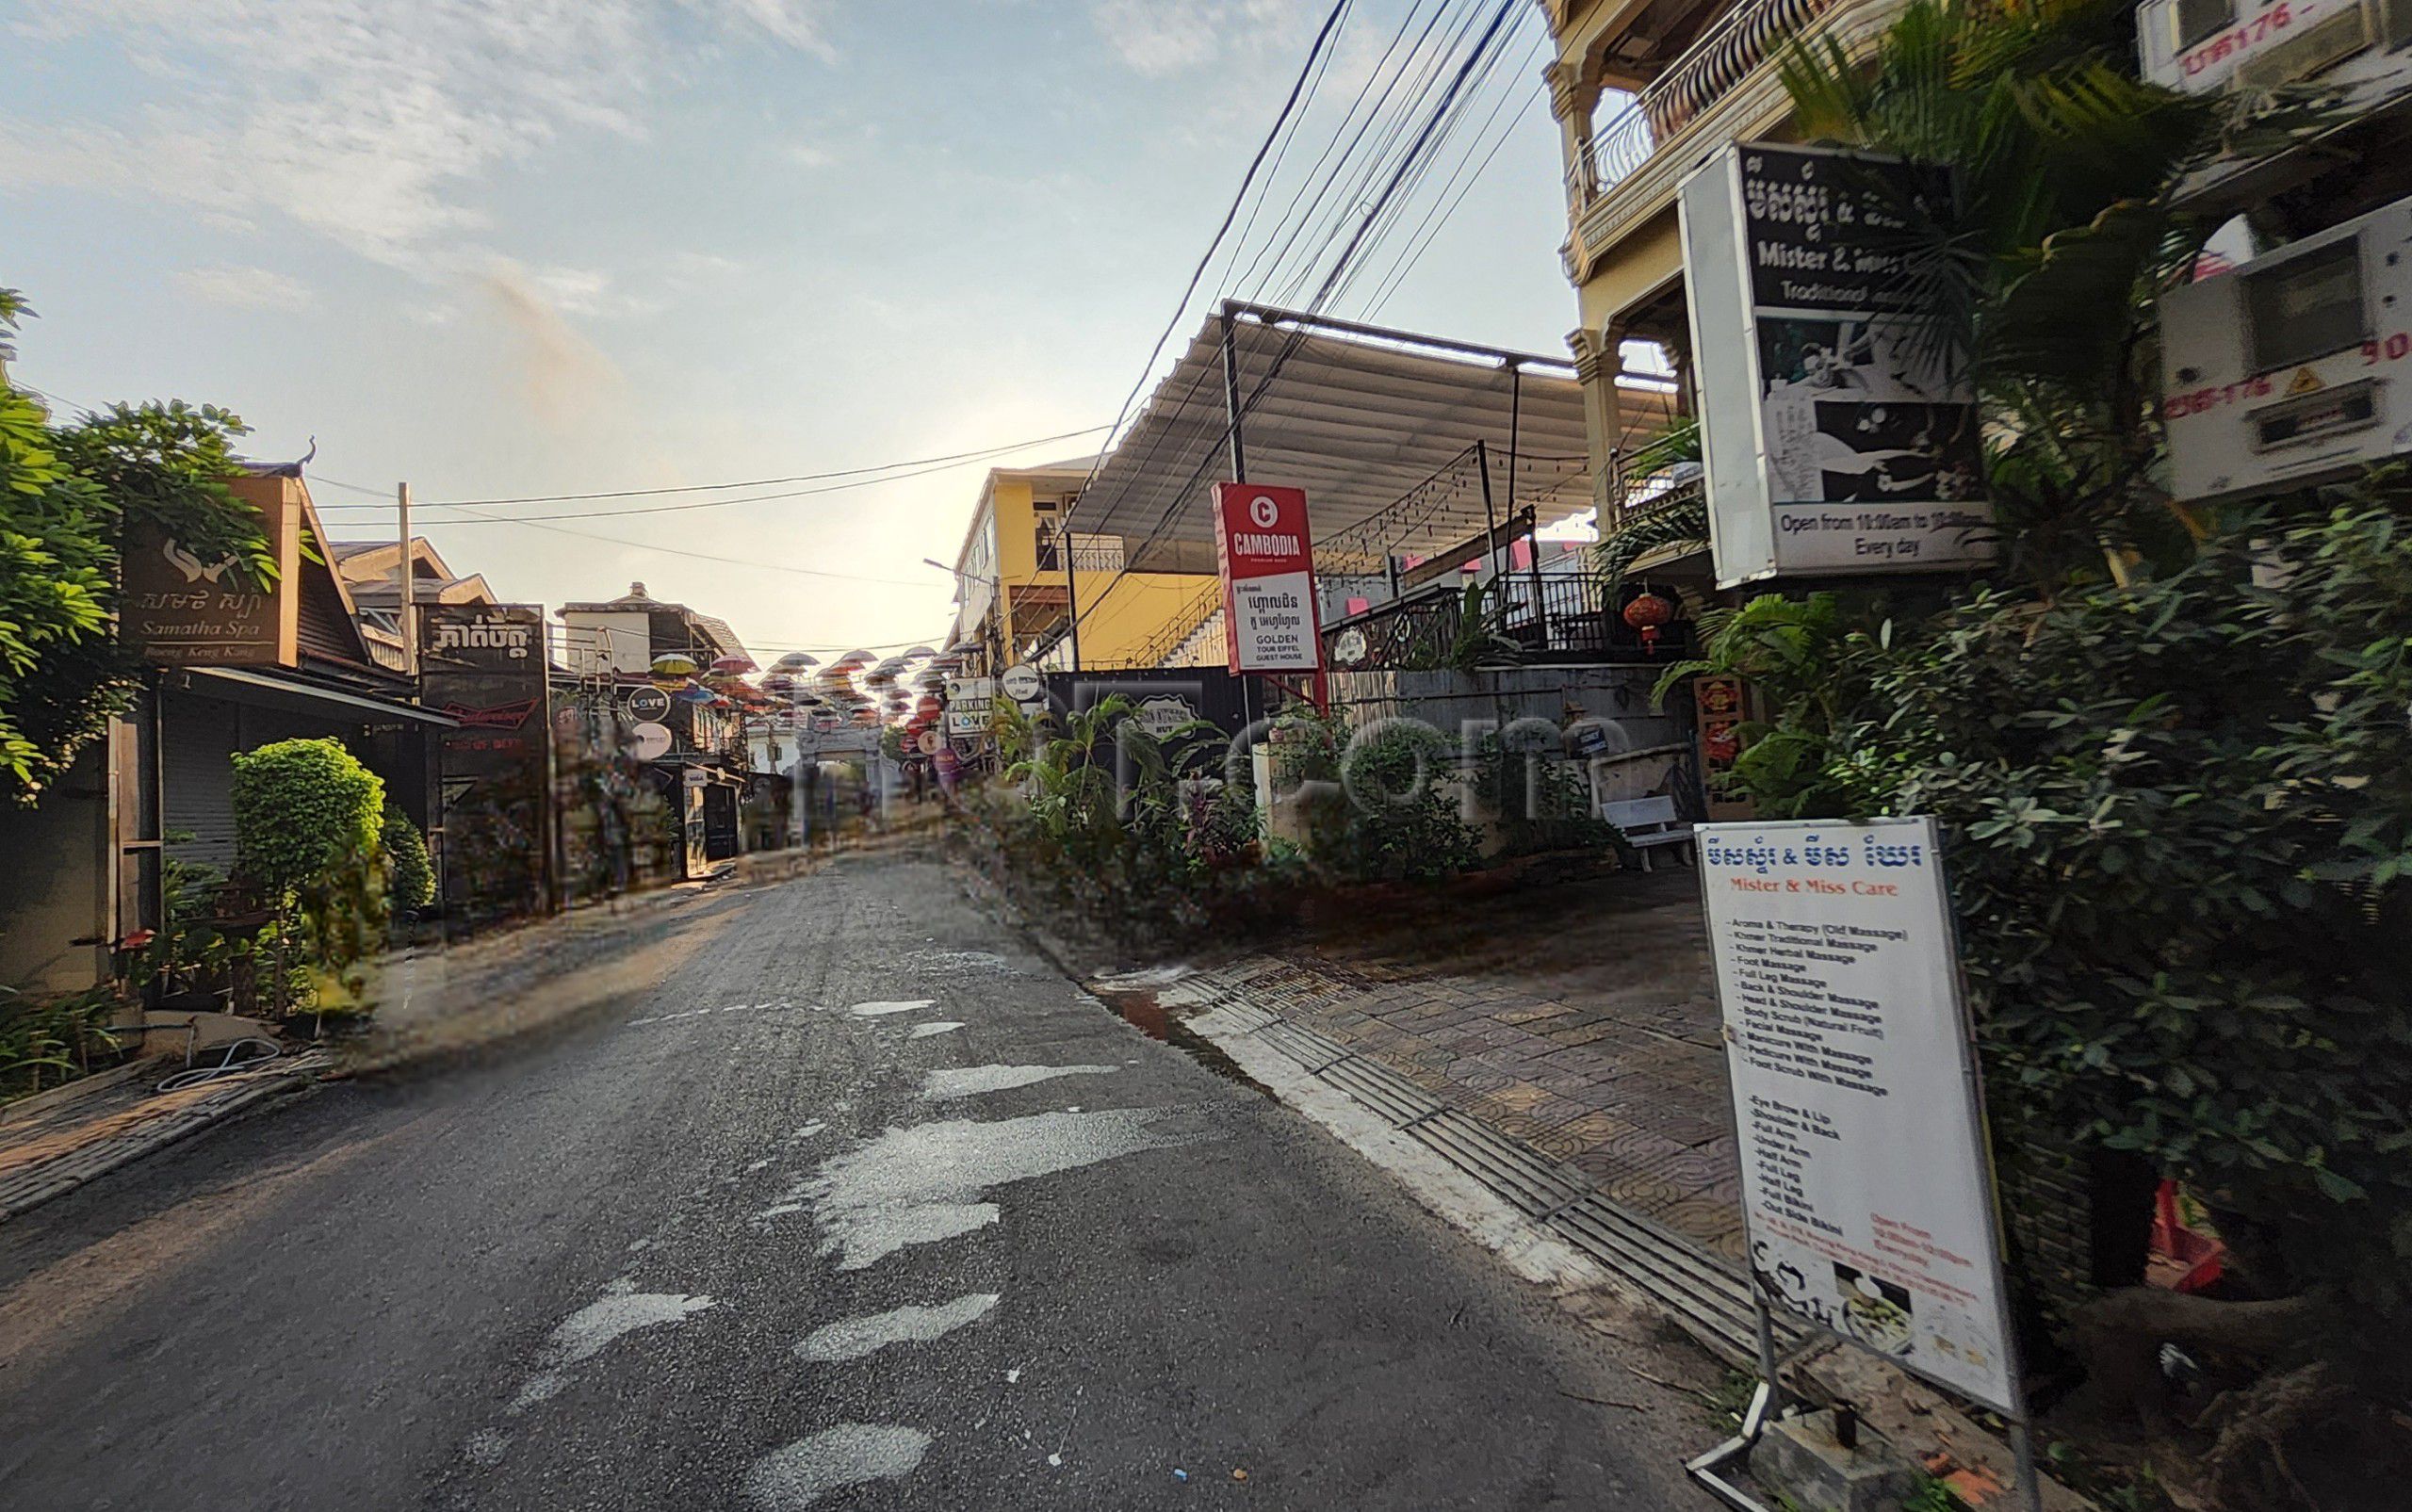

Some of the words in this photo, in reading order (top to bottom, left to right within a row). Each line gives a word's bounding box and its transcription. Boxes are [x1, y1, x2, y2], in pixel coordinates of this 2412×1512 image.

[1757, 240, 1828, 270] Mister
[1833, 246, 1851, 272] &
[1781, 514, 1818, 535] Open
[1821, 513, 1853, 530] from
[1914, 513, 1928, 528] to
[1233, 532, 1300, 557] CAMBODIA
[1855, 537, 1893, 558] Every
[1897, 537, 1921, 557] day
[141, 620, 221, 636] Samatha
[225, 621, 260, 639] Spa
[1256, 634, 1298, 644] GOLDEN
[631, 698, 665, 707] LOVE
[950, 699, 991, 711] PARKING
[952, 715, 988, 726] LOVE
[1783, 848, 1798, 865] &
[1730, 877, 1781, 892] Mister
[1785, 879, 1801, 893] &
[1806, 880, 1847, 894] Miss
[1851, 880, 1899, 896] Care
[1826, 938, 1878, 952] Massage
[1736, 956, 1759, 967] Foot
[1761, 959, 1807, 973] Massage
[1805, 950, 1856, 965] Massage
[1758, 971, 1778, 983] Leg
[1779, 973, 1827, 989] Massage
[1741, 982, 1764, 992] Back
[1777, 986, 1824, 1000] Shoulder
[1827, 992, 1880, 1010] Massage
[1743, 1006, 1768, 1020] Body
[1770, 1011, 1801, 1024] Scrub
[1779, 999, 1827, 1015] Shoulder
[1830, 1007, 1882, 1025] Massage
[1745, 1018, 1773, 1032] Facial
[1776, 1024, 1823, 1042] Massage
[1820, 1046, 1873, 1065] Massage
[1750, 1057, 1772, 1069] Foot
[1774, 1063, 1805, 1078] Scrub
[1834, 1076, 1888, 1097] Massage
[1820, 1060, 1872, 1079] Massage
